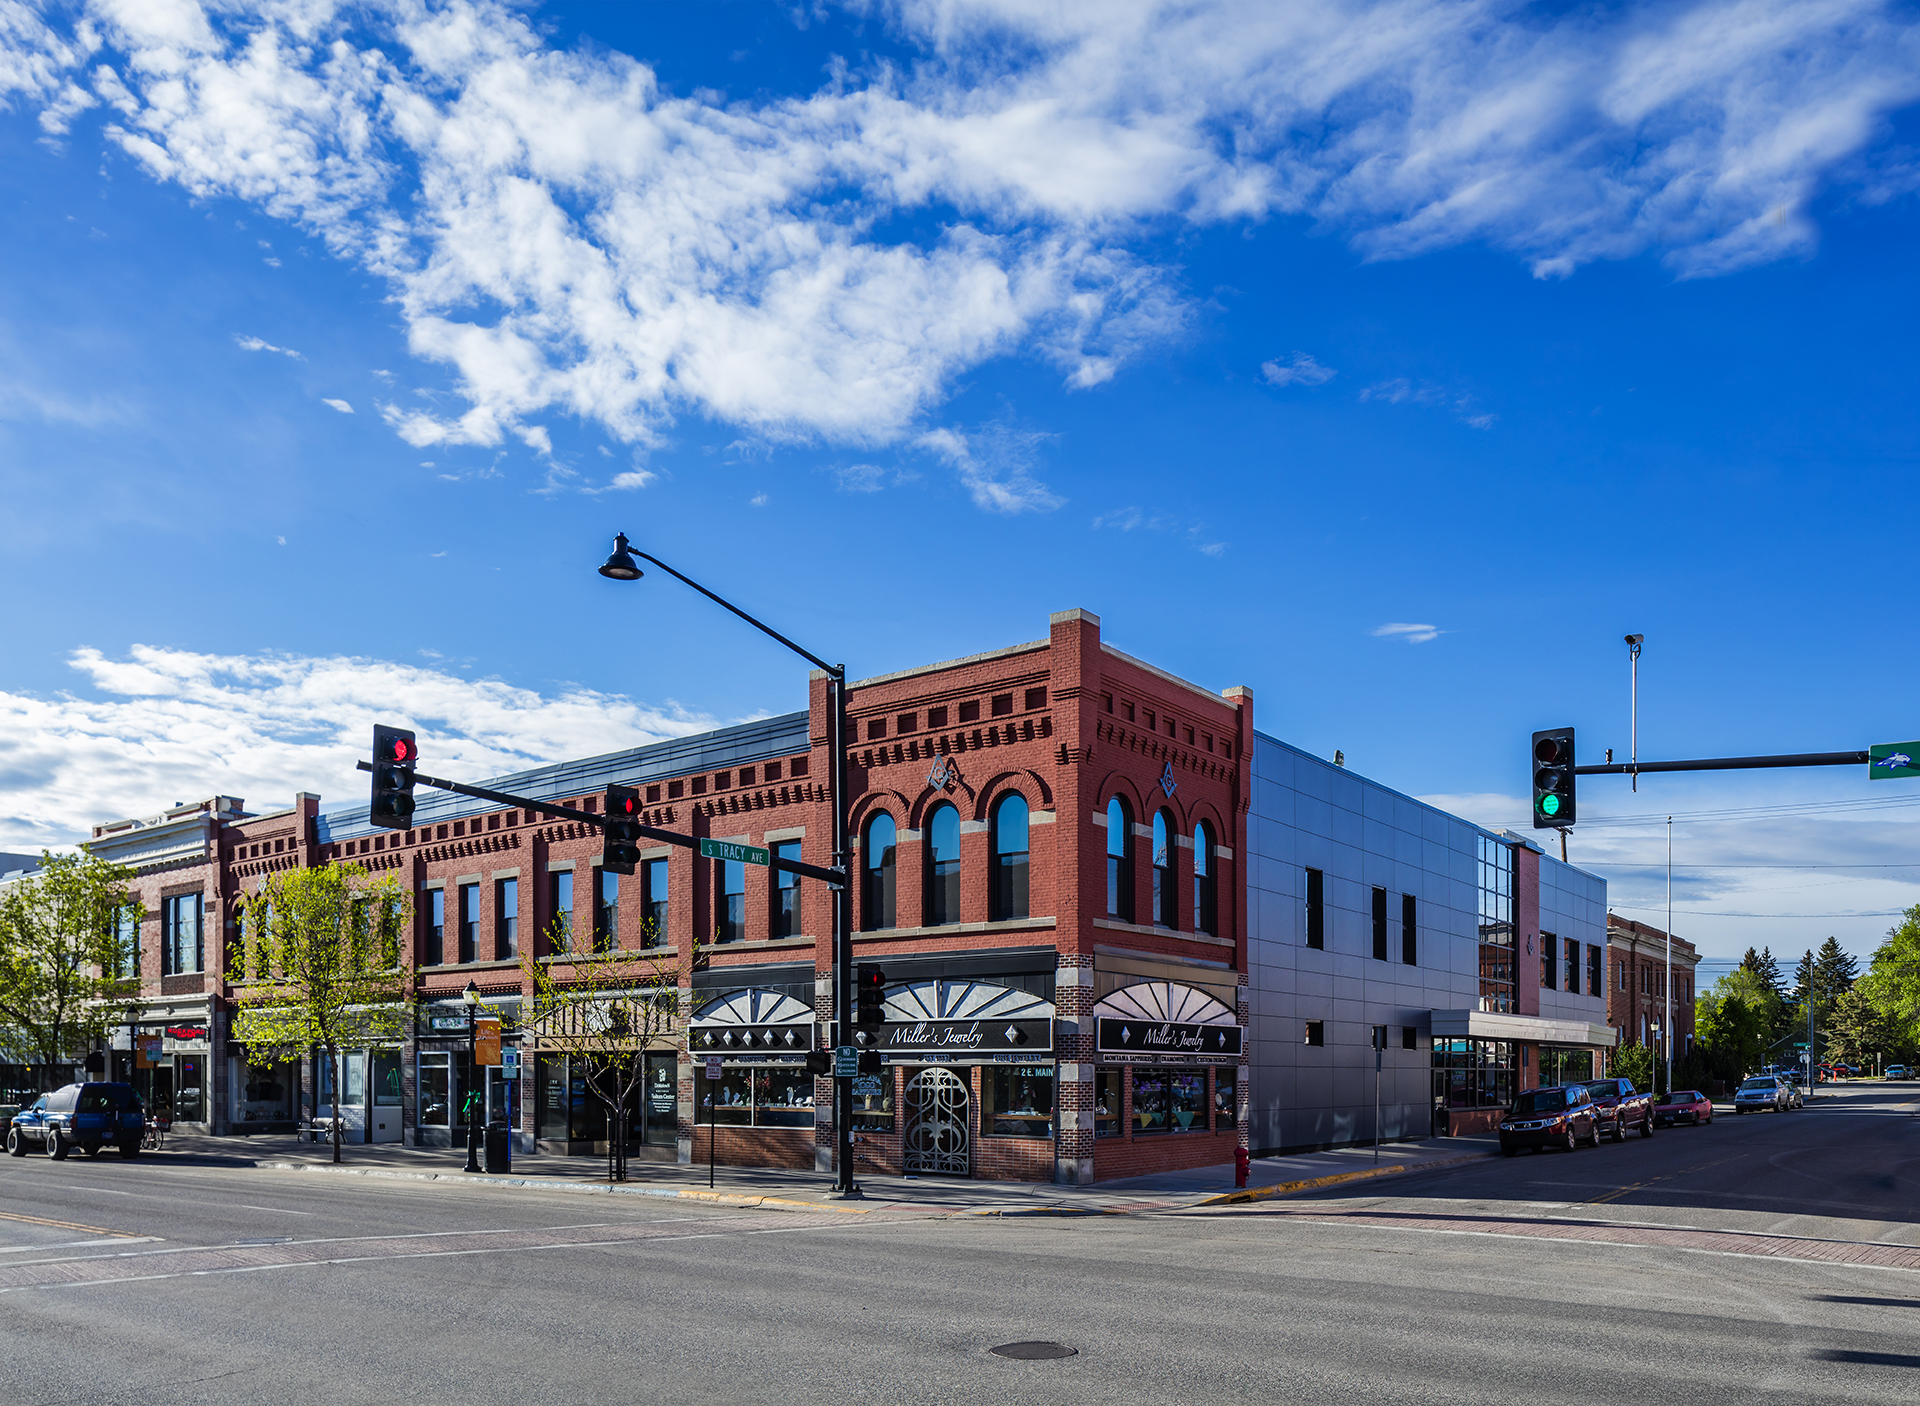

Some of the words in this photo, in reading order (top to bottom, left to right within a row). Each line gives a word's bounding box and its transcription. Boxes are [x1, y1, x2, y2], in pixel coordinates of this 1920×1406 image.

[934, 766, 944, 779] G
[1165, 774, 1172, 787] G
[708, 844, 713, 855] S
[719, 843, 746, 860] TRACY
[751, 852, 763, 864] AVE
[890, 1021, 939, 1045] Miller's
[938, 1021, 983, 1049] Jewelry
[1143, 1023, 1177, 1046] Miller's
[1176, 1025, 1204, 1052] Jewelry
[1021, 1068, 1026, 1076] 2
[1035, 1068, 1053, 1076] MAIN
